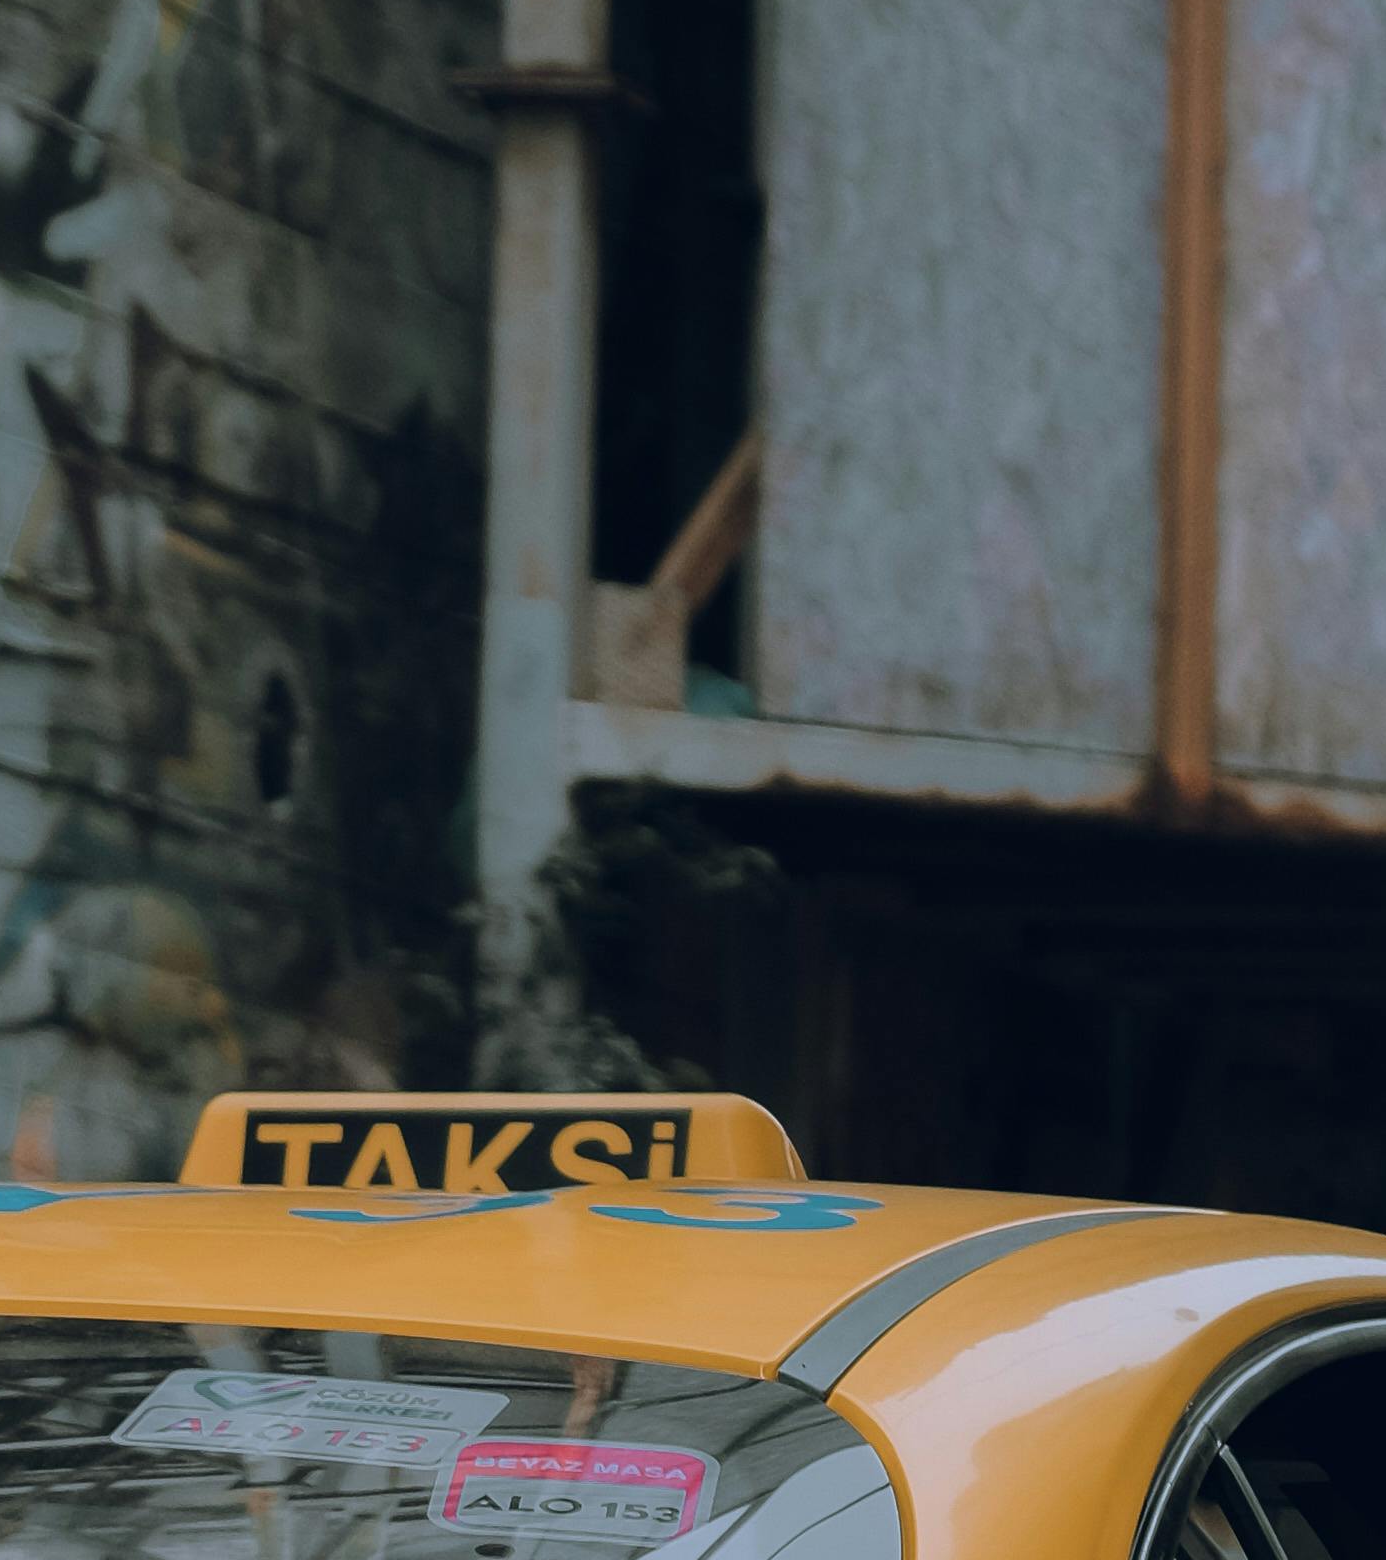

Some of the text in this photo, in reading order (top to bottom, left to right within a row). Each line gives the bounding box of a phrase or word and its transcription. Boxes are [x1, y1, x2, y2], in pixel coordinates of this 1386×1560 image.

[159, 1416, 429, 1453] ALO 153
[474, 1455, 689, 1481] BEYAZ MASA
[463, 1493, 682, 1524] ALO 153
